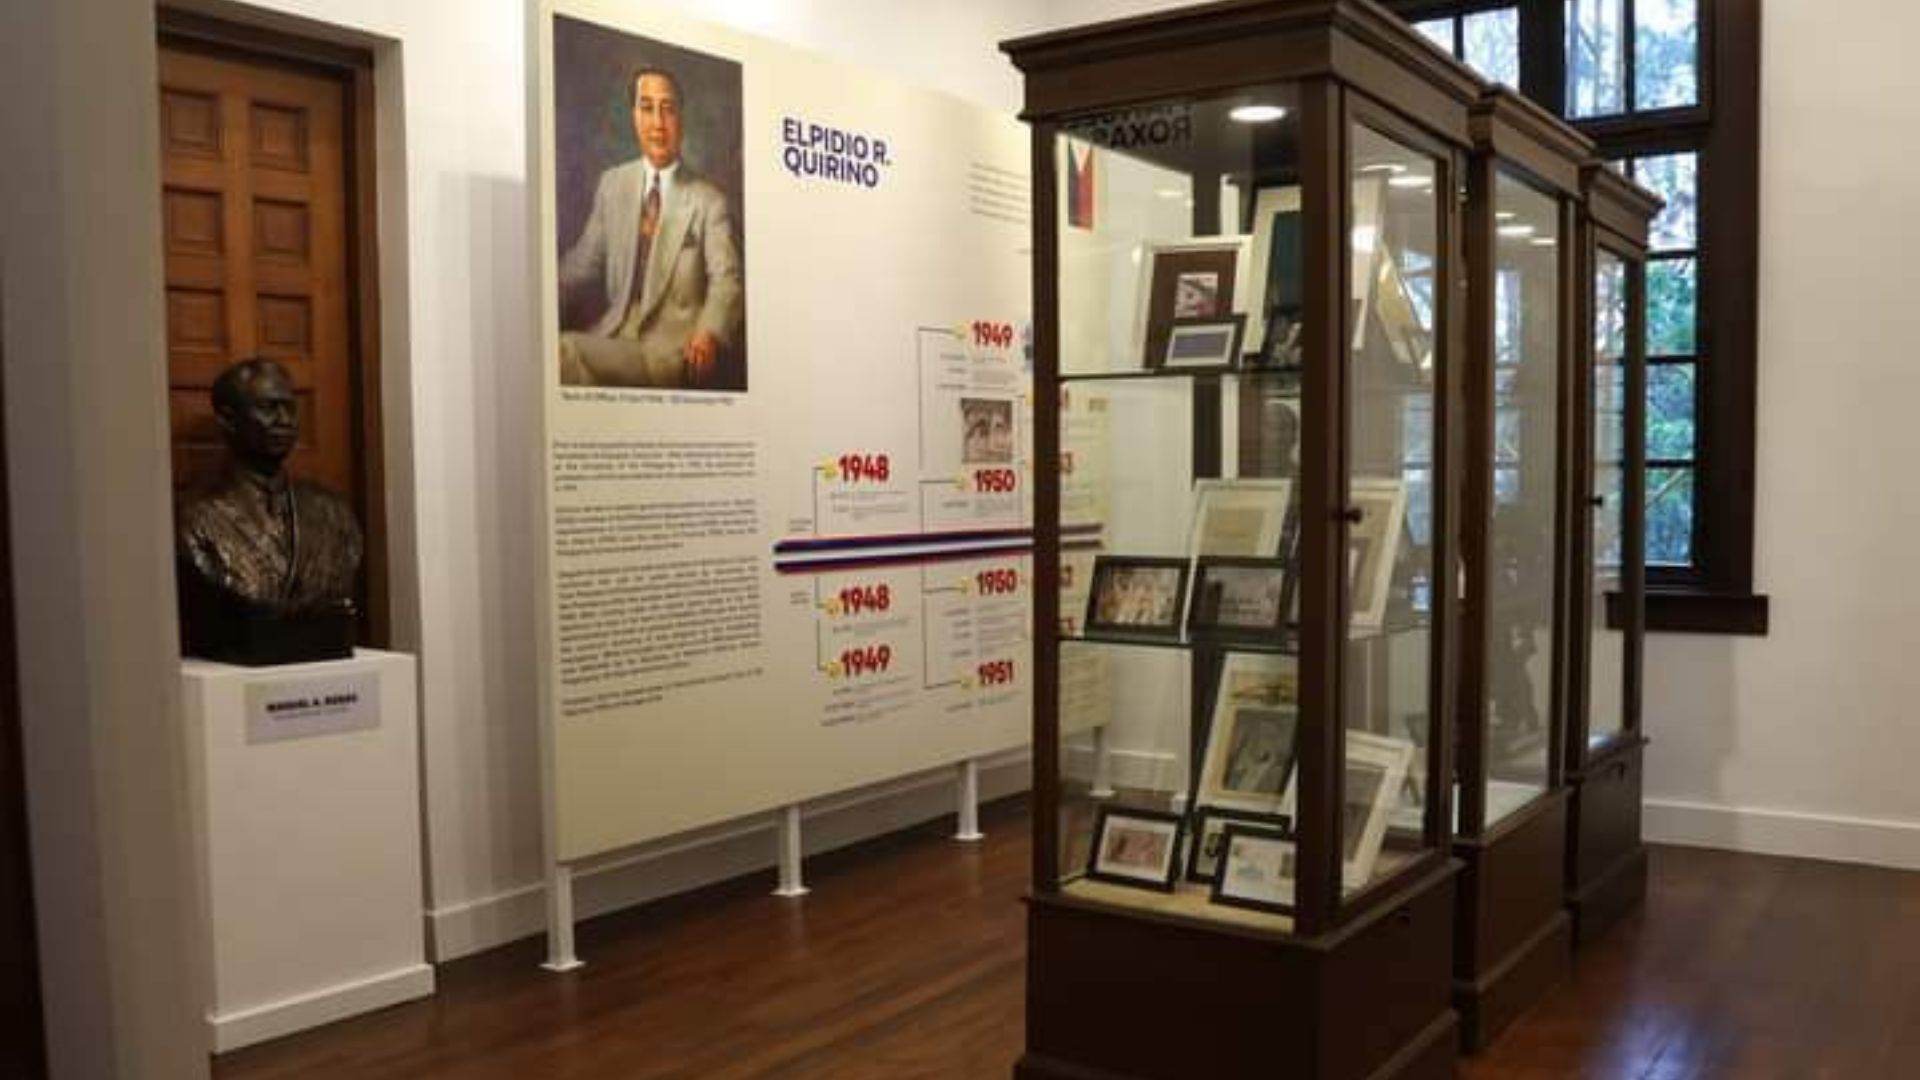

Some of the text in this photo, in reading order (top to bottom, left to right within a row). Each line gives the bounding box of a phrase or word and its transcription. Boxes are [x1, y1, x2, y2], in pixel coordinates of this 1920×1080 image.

[783, 116, 891, 167] ELPIDIO R.
[783, 145, 879, 188] QUIRINO
[973, 322, 1014, 347] 1949
[839, 453, 889, 483] 1948
[974, 468, 1016, 493] 1950
[976, 568, 1017, 596] 1950
[839, 584, 891, 615] 1948
[841, 645, 891, 677] 1949
[978, 660, 1014, 687] 1951
